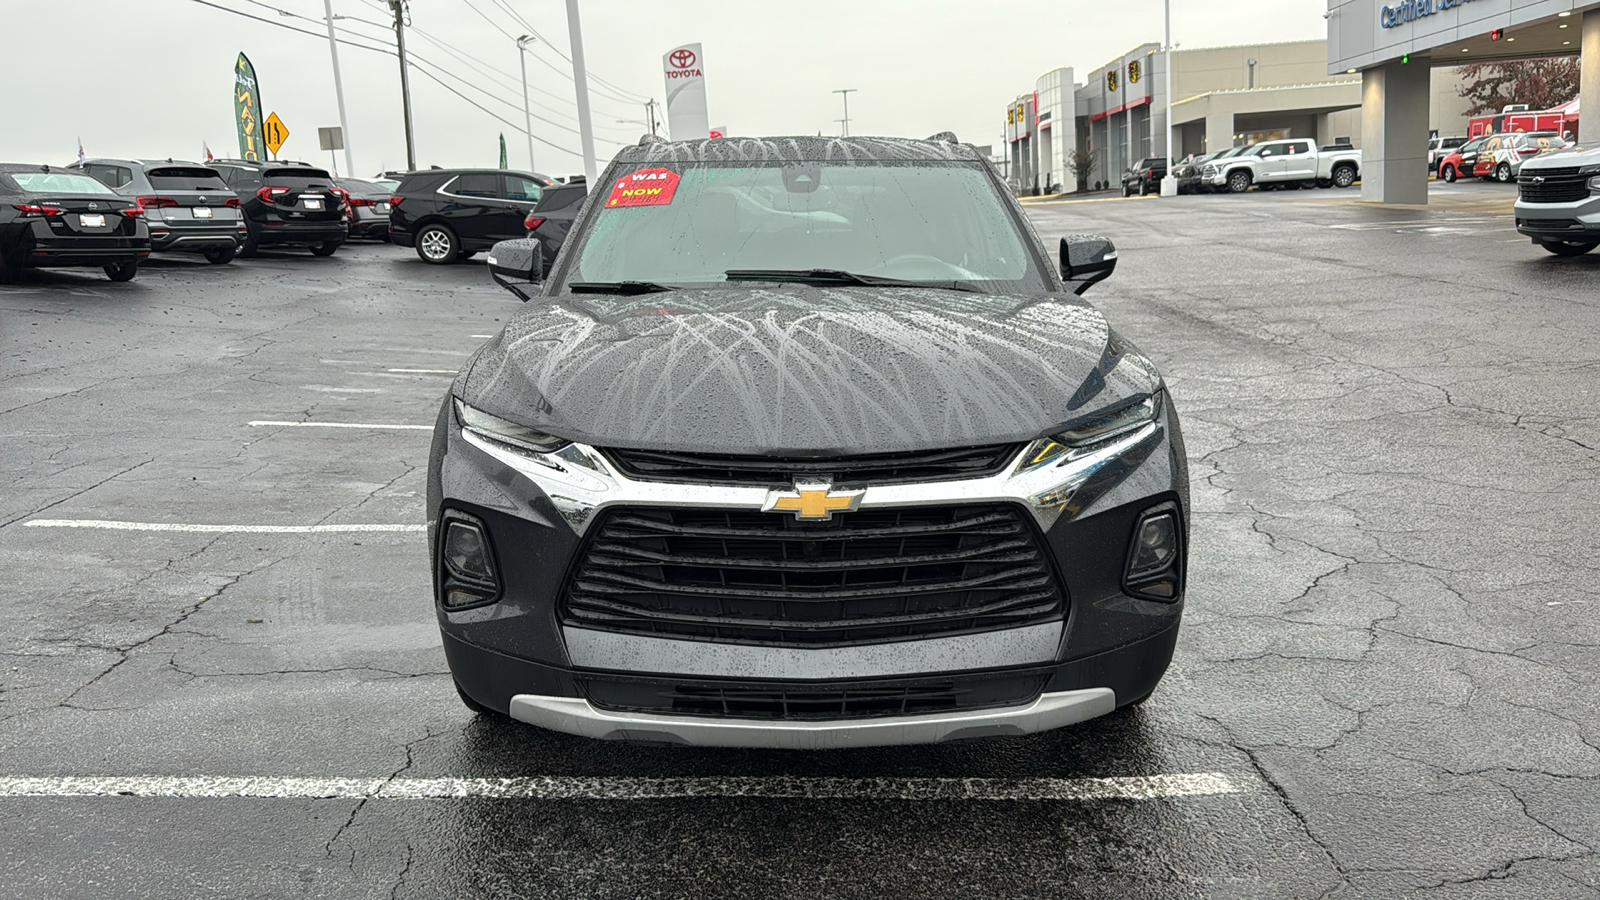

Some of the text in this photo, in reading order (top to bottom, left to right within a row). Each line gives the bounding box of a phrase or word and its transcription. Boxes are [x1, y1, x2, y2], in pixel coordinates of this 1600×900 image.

[1381, 0, 1433, 29] Certified
[666, 69, 702, 79] TOYOTA
[632, 173, 667, 181] WAS
[621, 187, 663, 197] NOW
